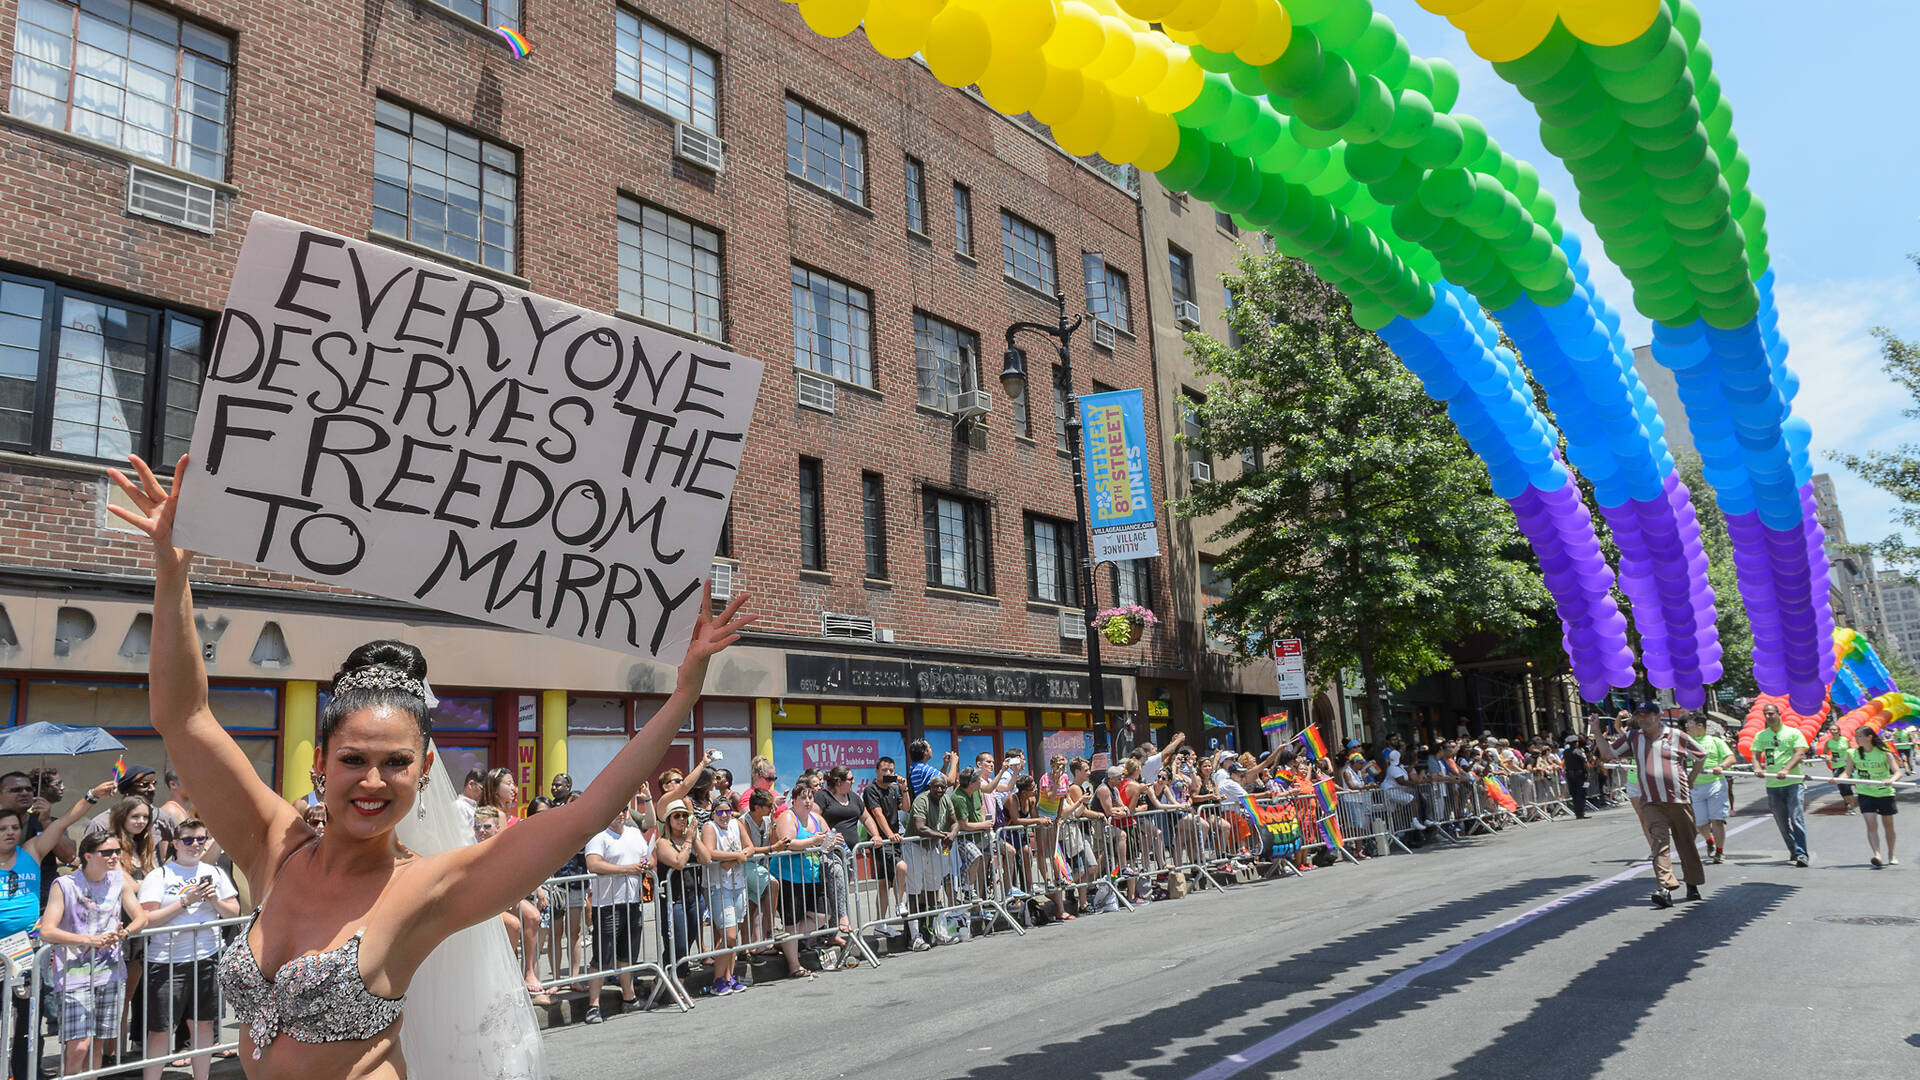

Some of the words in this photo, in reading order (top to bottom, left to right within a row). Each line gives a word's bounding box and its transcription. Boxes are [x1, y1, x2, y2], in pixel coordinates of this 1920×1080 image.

[274, 231, 731, 419] EVERYONE
[207, 307, 594, 463] DESERVES
[613, 401, 743, 500] THE
[1105, 408, 1126, 482] STREET
[1126, 445, 1147, 511] DINES
[205, 394, 686, 565] FREEDOM
[1103, 542, 1139, 555] ALLIANCE
[1116, 531, 1147, 544] VILLAGE
[225, 486, 366, 576] TO
[414, 529, 701, 657] MARRY
[917, 670, 988, 696] SPORTS
[993, 675, 1028, 697] CAP
[1050, 679, 1080, 699] HAT
[969, 712, 980, 724] 65
[168, 882, 184, 896] I'M
[185, 878, 198, 886] SO
